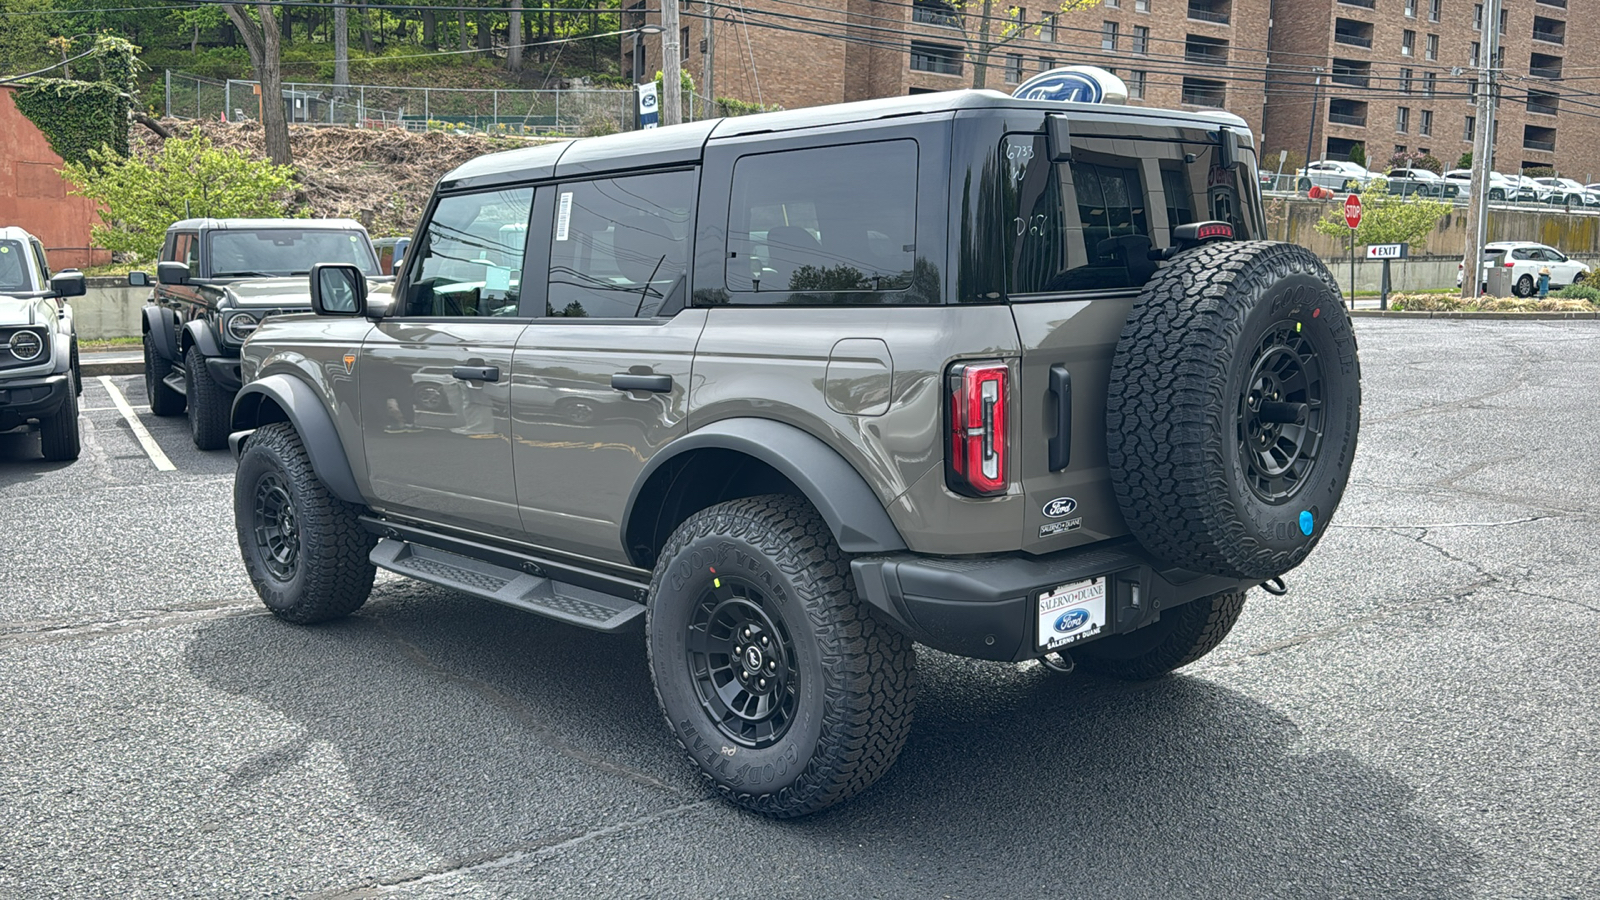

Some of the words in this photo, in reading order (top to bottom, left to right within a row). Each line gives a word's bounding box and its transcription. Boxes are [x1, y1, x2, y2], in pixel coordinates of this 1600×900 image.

[1006, 143, 1035, 160] 6733
[1346, 205, 1361, 218] STOP
[1378, 246, 1398, 256] EXIT
[670, 541, 788, 606] GOODYEAR
[1040, 593, 1075, 612] SALERNO
[1077, 584, 1104, 601] DUANE
[1060, 612, 1083, 630] Ford
[1046, 636, 1075, 650] SALERNO
[1082, 627, 1101, 639] DUANE
[680, 718, 799, 787] GOODYEAR
